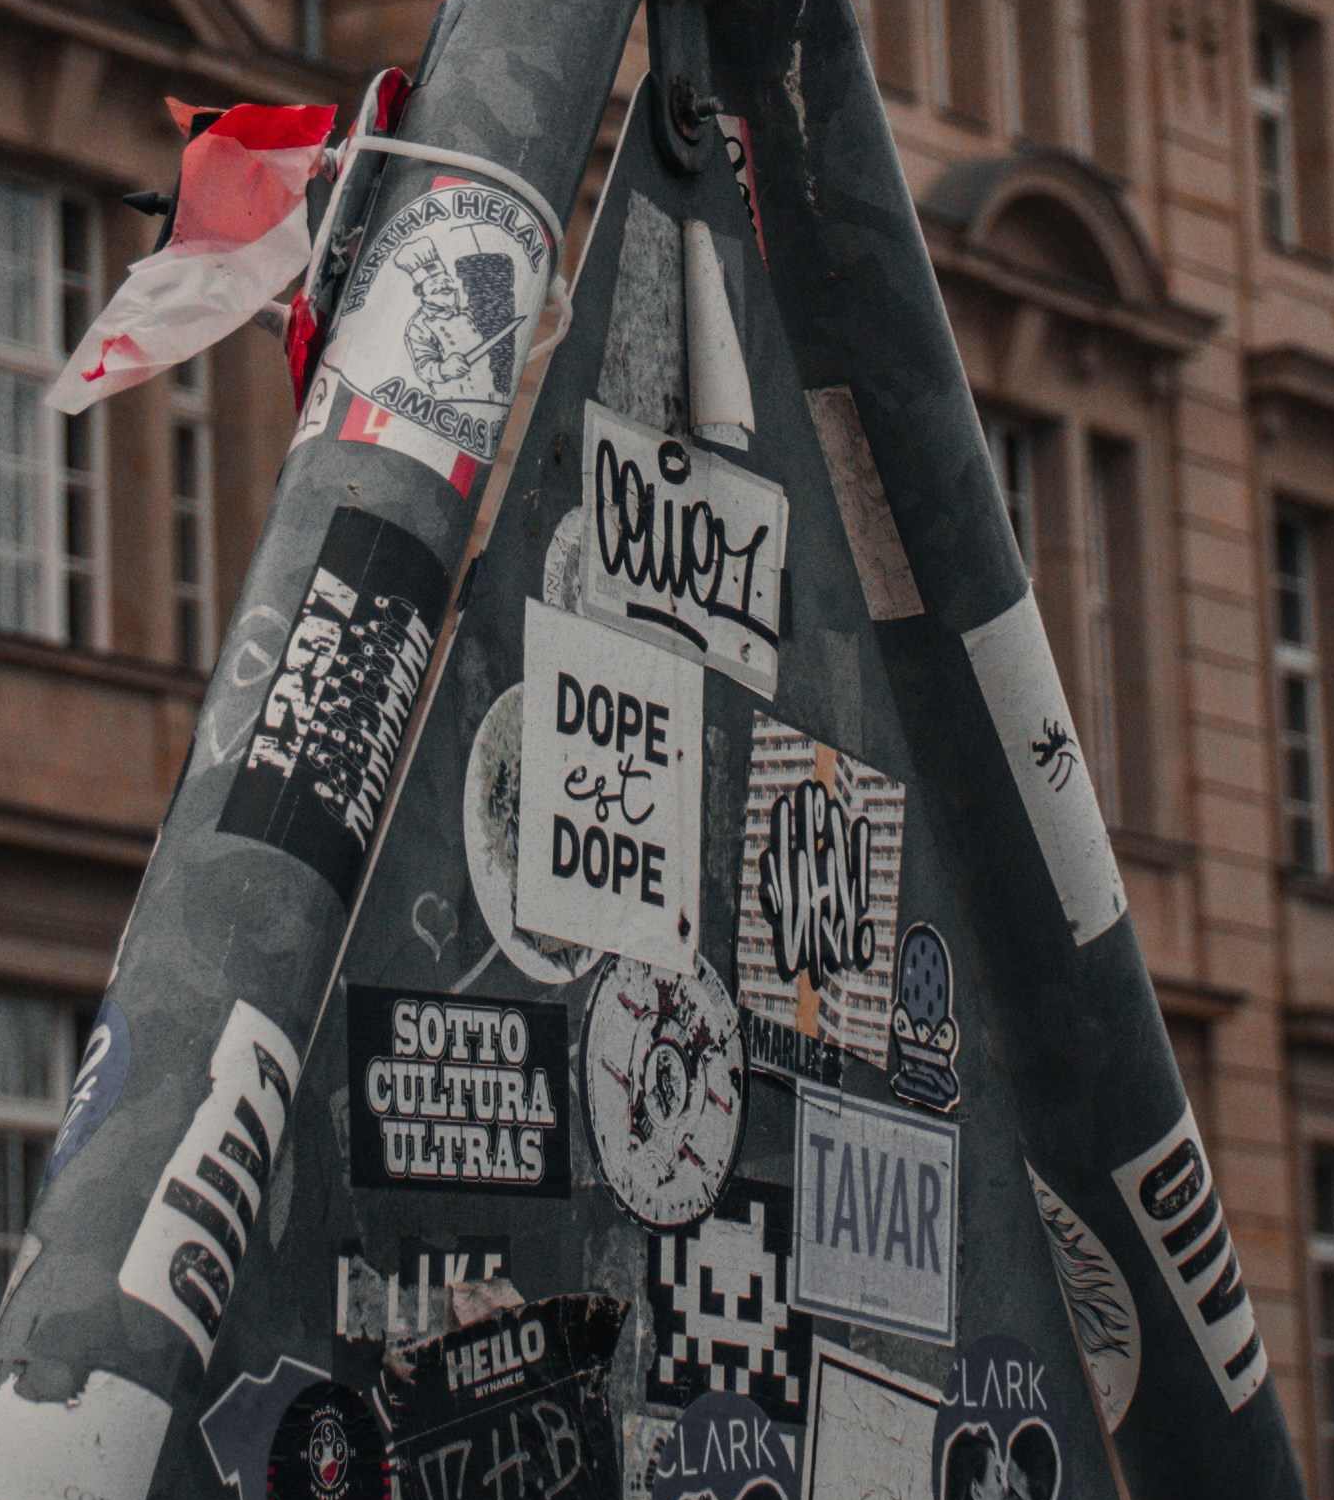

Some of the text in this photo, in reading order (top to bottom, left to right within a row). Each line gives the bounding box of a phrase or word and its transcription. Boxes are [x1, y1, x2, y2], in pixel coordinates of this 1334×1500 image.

[342, 190, 546, 317] HERTHA HELAL
[555, 671, 669, 767] DOPE
[563, 753, 655, 825] est
[551, 813, 666, 907] DOPE
[392, 999, 529, 1066] SOTTO
[366, 1056, 557, 1128] CULTURA
[380, 1116, 545, 1184] ULTRAS
[809, 1133, 942, 1276] TAVAR
[445, 1319, 546, 1392] HELLO
